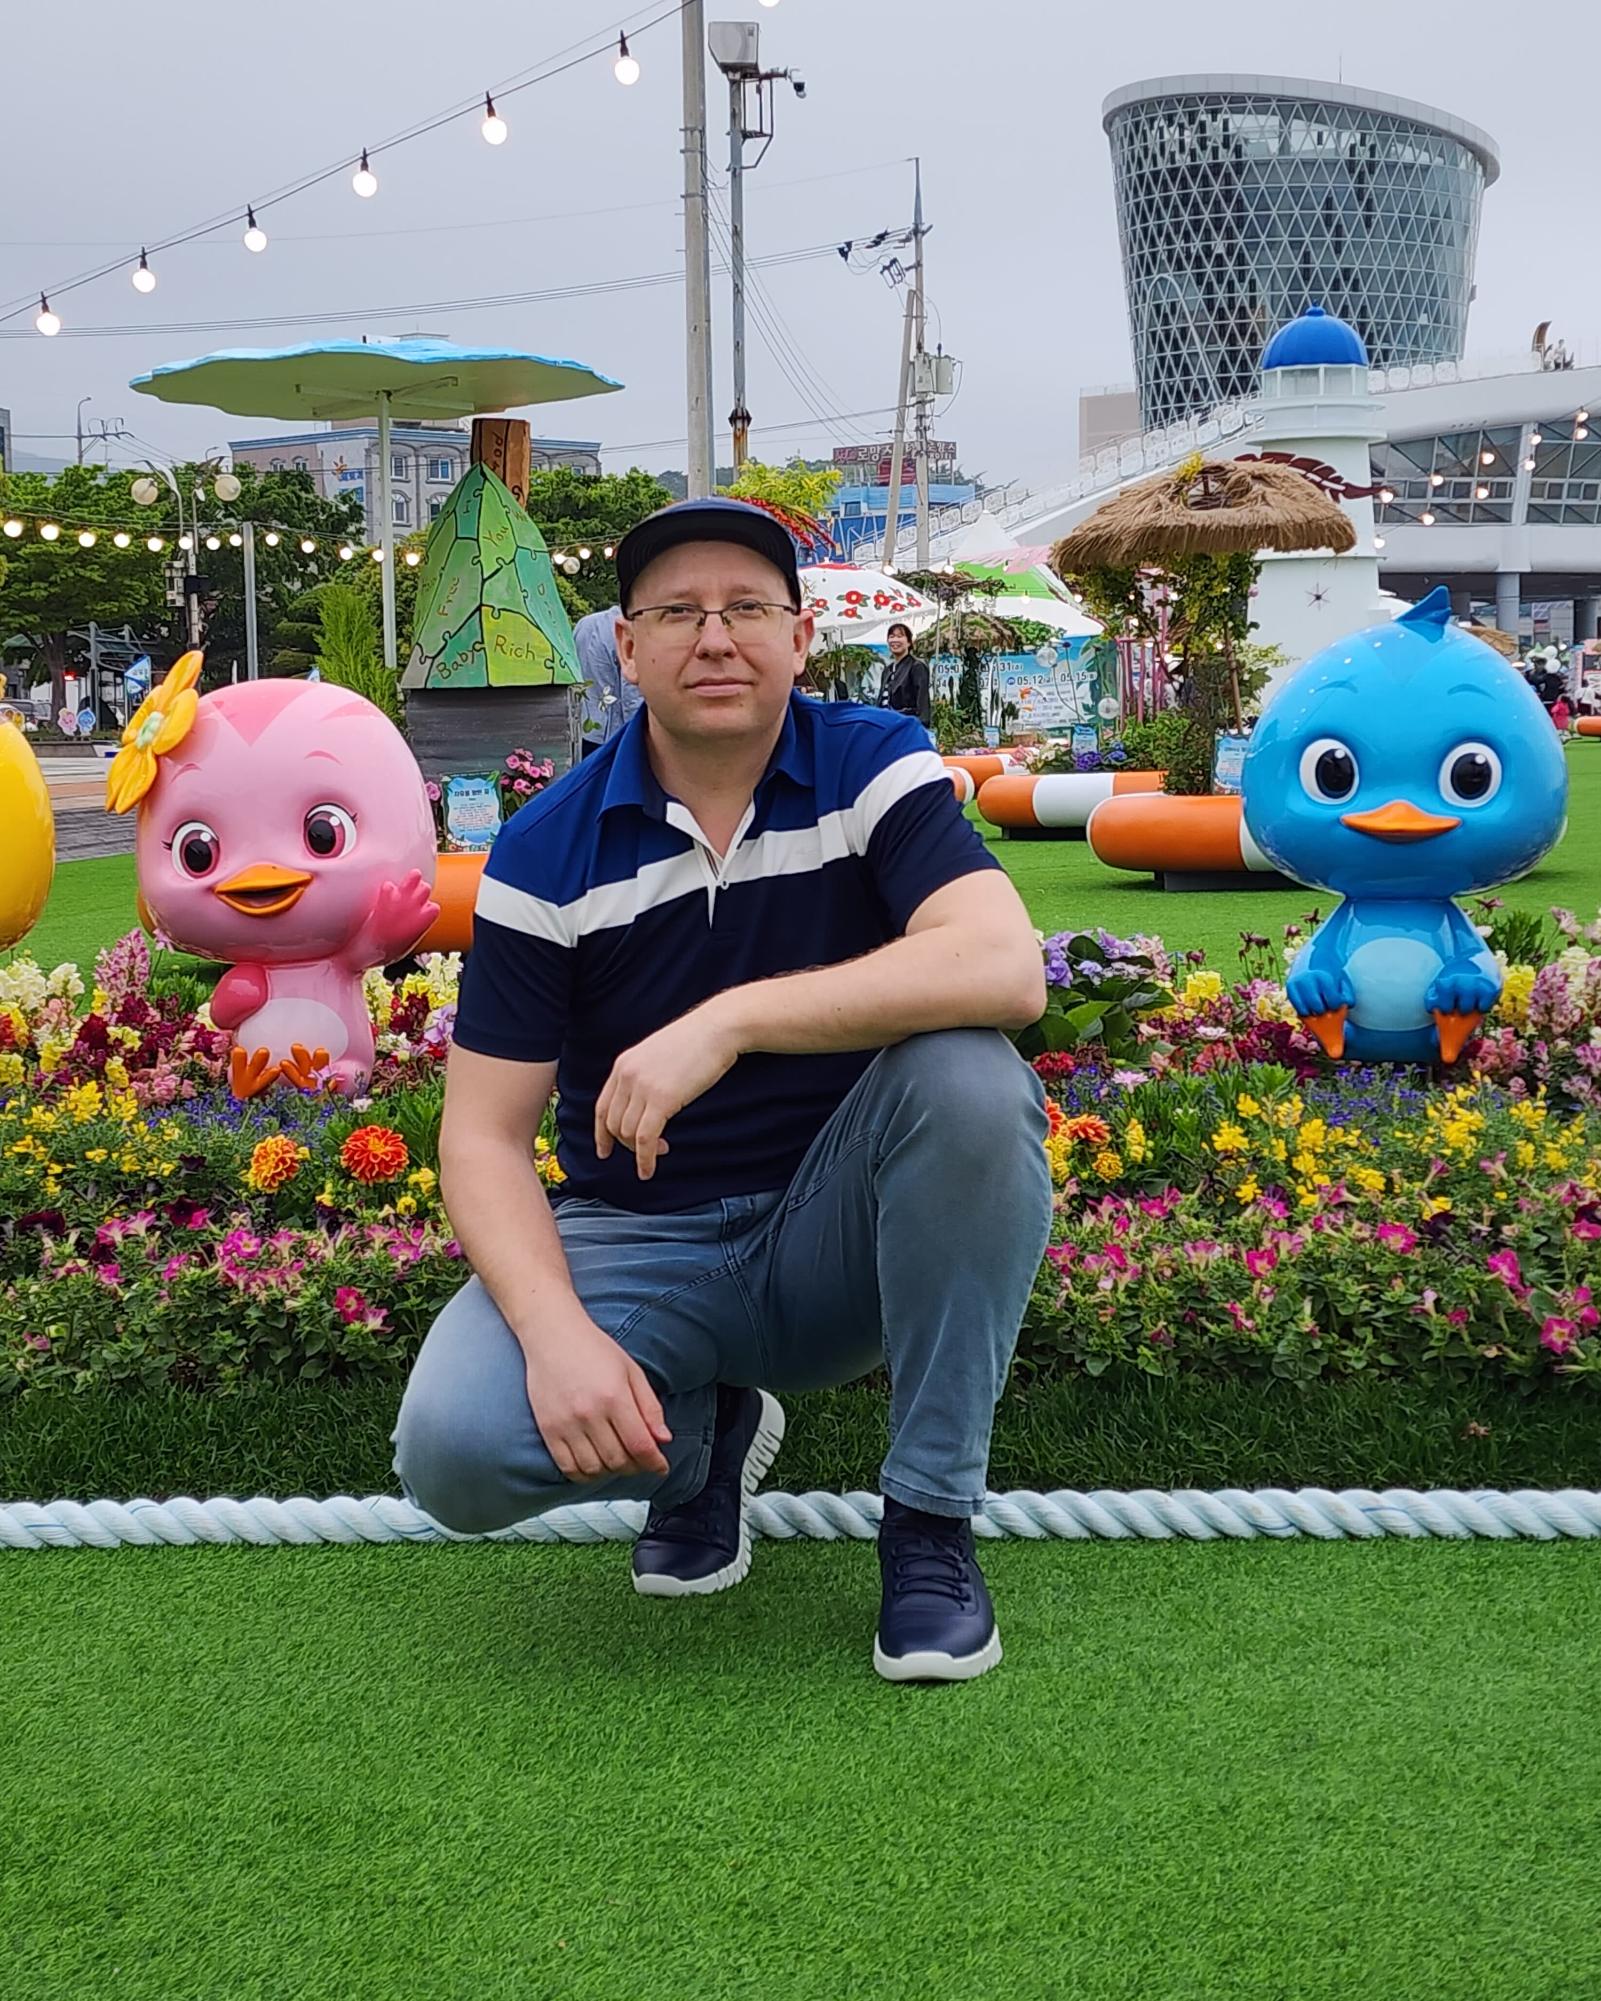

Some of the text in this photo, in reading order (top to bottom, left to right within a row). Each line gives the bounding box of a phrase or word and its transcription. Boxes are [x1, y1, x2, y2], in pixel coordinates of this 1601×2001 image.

[482, 526, 509, 547] You
[493, 634, 536, 661] Rich
[436, 648, 476, 679] Baby
